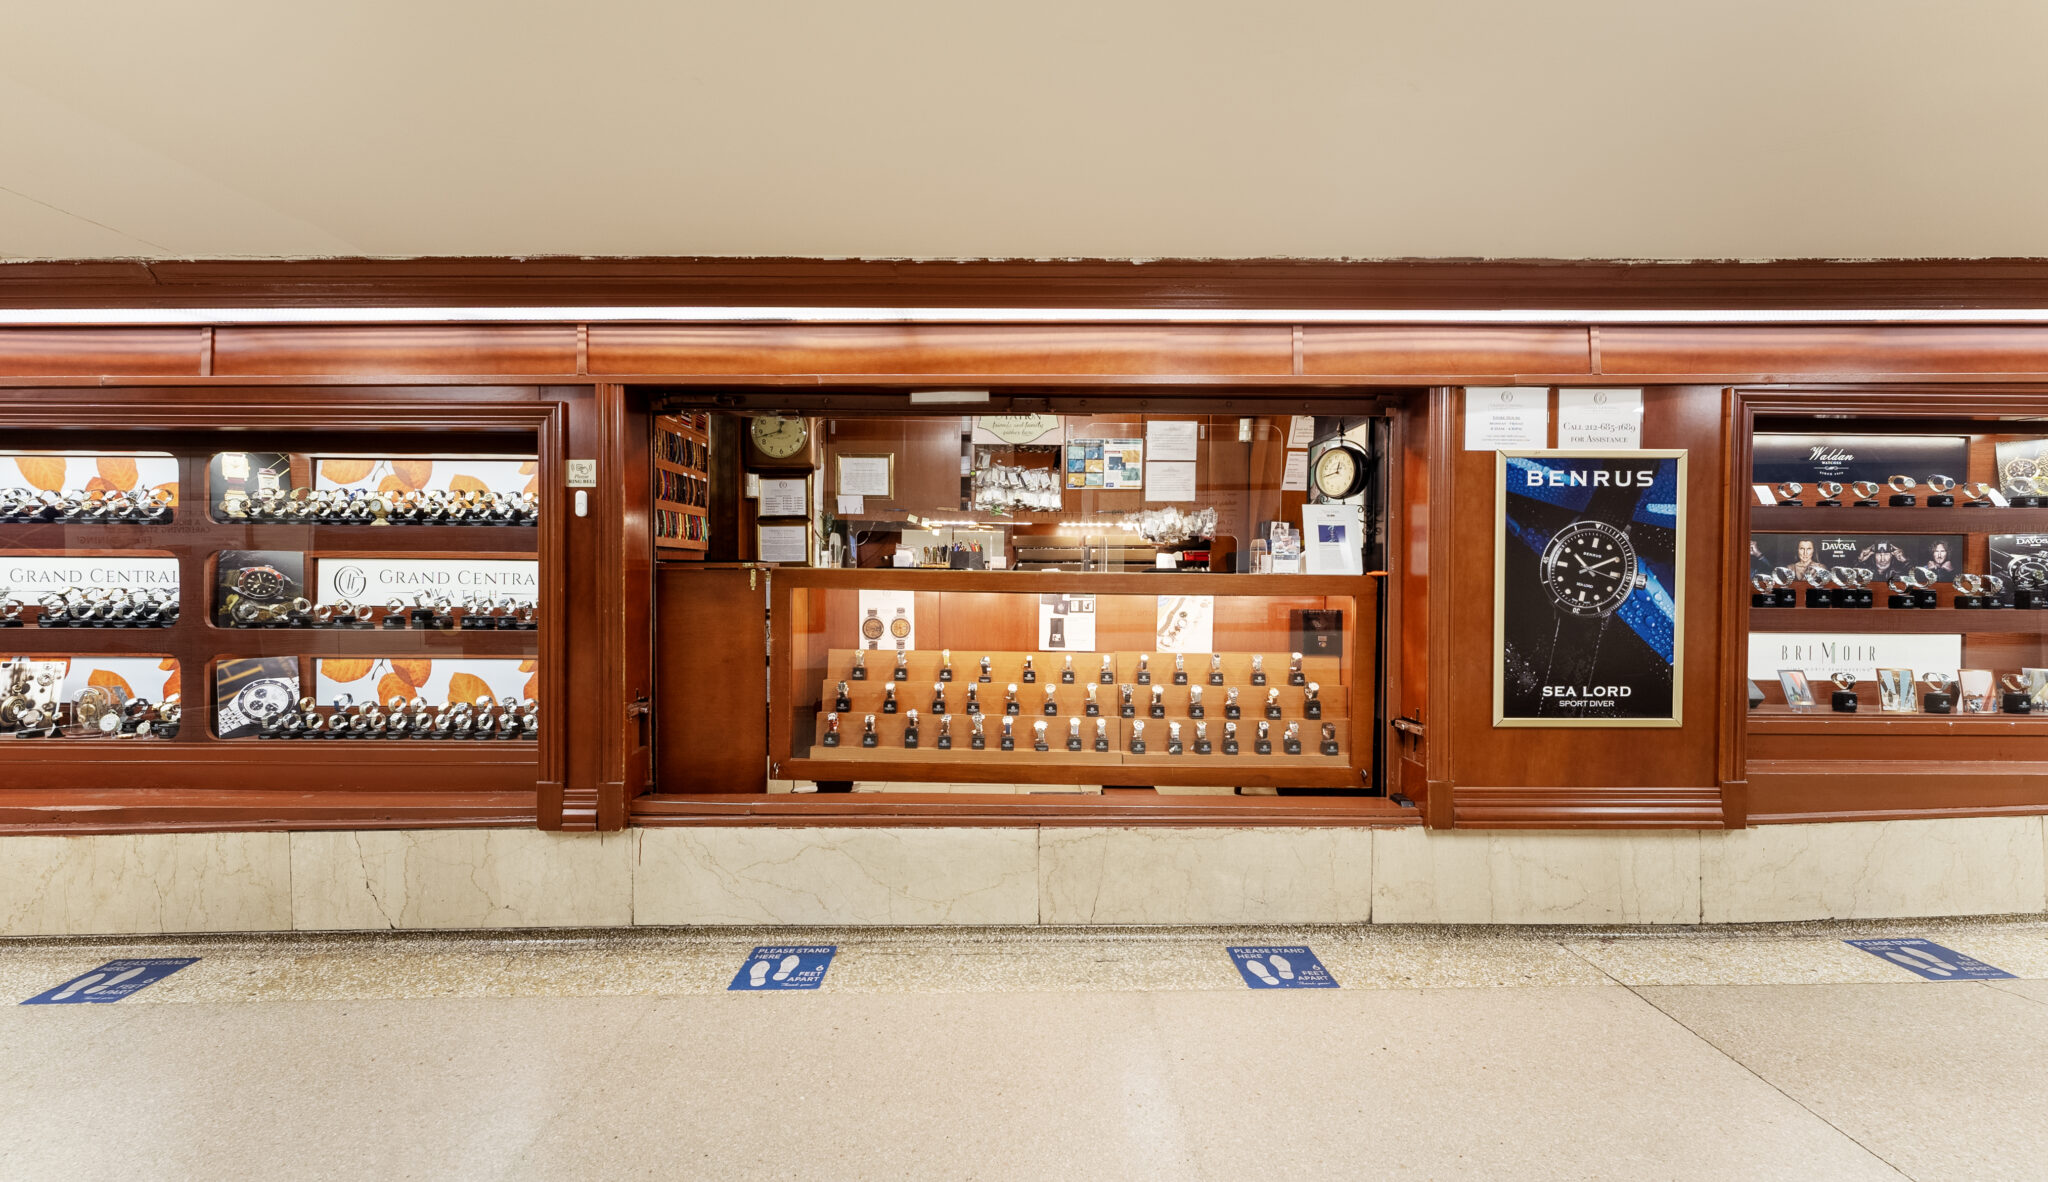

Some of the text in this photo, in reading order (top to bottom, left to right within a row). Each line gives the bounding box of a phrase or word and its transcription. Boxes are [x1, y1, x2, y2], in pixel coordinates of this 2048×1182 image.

[1585, 423, 1636, 432] 212-685-1689
[1809, 446, 1854, 461] Waldan
[1527, 470, 1654, 487] BENRUS
[1821, 542, 1857, 551] DAVOSA
[9, 568, 179, 583] GRAND CENTRAL
[379, 569, 450, 584] GRAND
[1781, 641, 1875, 664] BRIMOIR
[1542, 686, 1632, 697] SEA LORD
